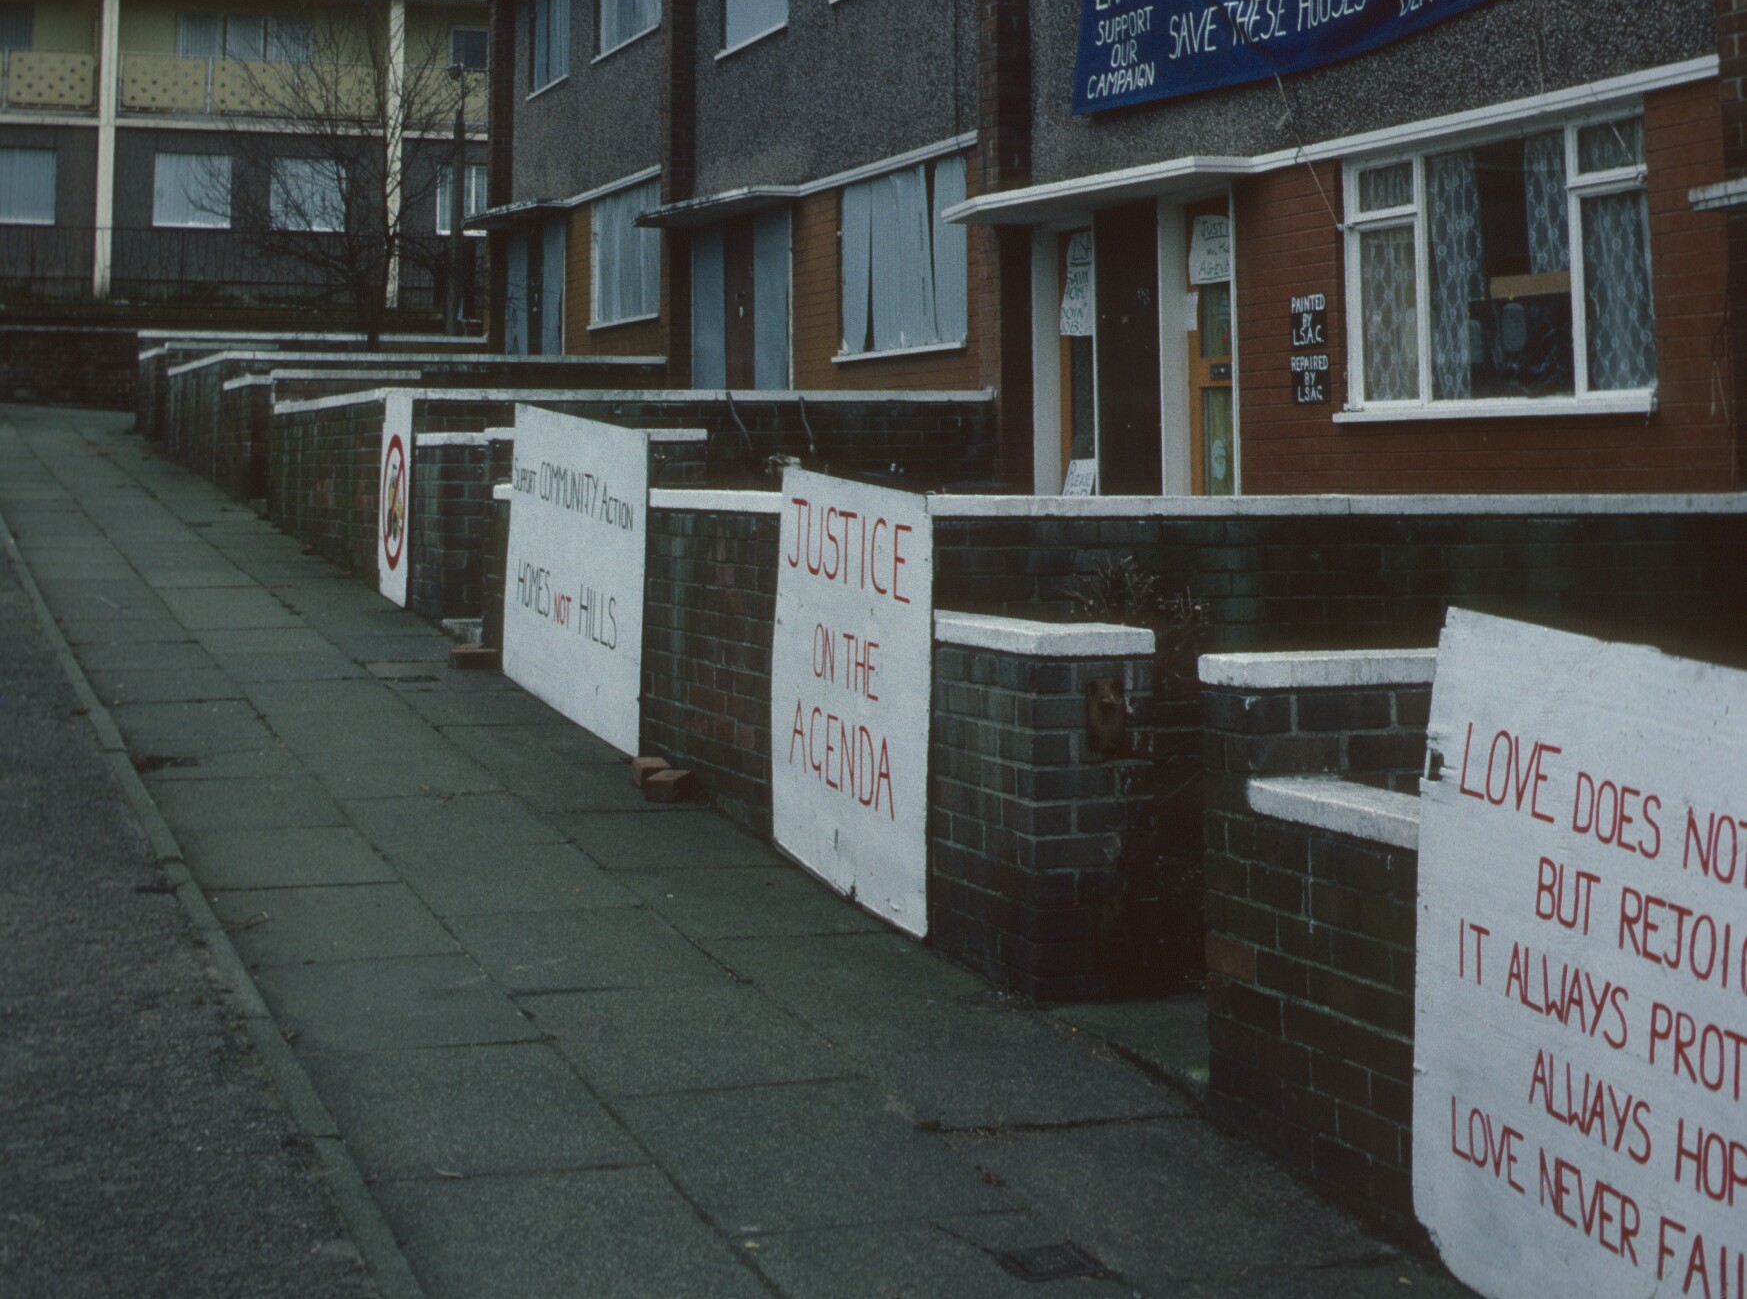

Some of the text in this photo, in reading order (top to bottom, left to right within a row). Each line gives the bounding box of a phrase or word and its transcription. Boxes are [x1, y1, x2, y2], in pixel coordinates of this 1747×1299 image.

[1095, 5, 1154, 46] SUPPORT
[1110, 39, 1138, 68] OUR
[1169, 5, 1218, 59] SAVE
[1087, 61, 1155, 99] CAMPAIGN
[1291, 293, 1325, 314] PAINTED
[1302, 313, 1312, 328] BY
[1291, 355, 1328, 371] REPAIRED
[1304, 372, 1316, 386] BY
[539, 461, 599, 518] COMMUNITY
[600, 481, 634, 532] ACTION
[787, 497, 912, 604] JUSTICE
[517, 558, 617, 651] HOMES NOT HILLS
[813, 623, 879, 701] ON THE
[789, 699, 894, 821] AGENDA
[1459, 722, 1562, 824] LOVE
[1573, 770, 1662, 860] DOES
[1535, 857, 1601, 935] BUT
[1458, 918, 1747, 1102] IT ALWAYS PROT
[1528, 1049, 1747, 1206] ALWAYS HOP
[1451, 1094, 1525, 1194] LOVE
[1539, 1147, 1638, 1266] NEVER
